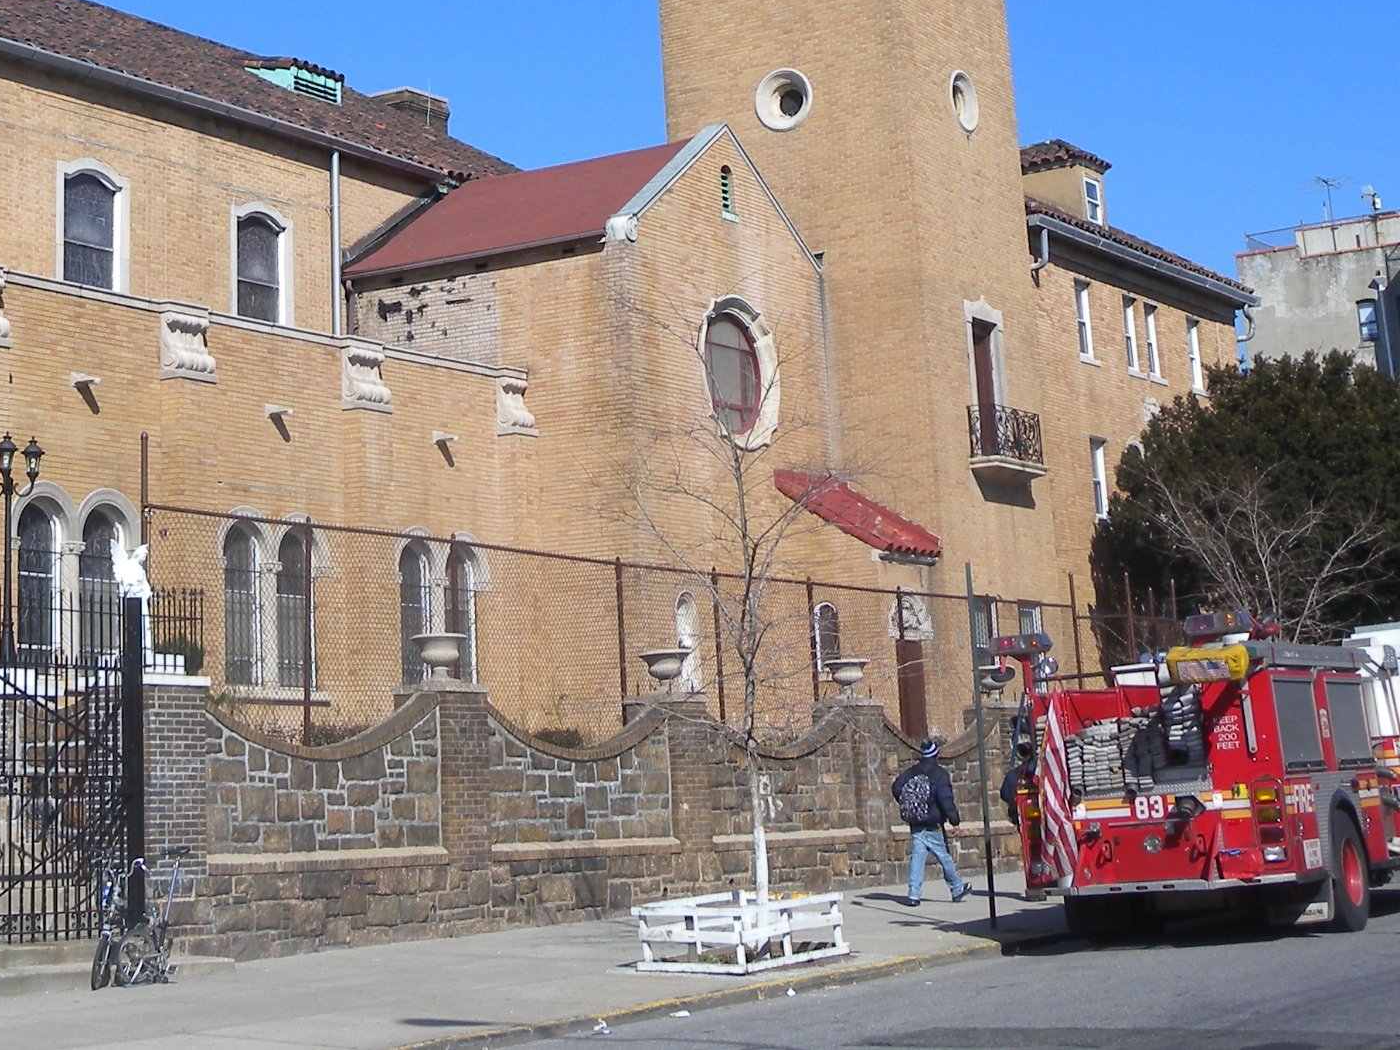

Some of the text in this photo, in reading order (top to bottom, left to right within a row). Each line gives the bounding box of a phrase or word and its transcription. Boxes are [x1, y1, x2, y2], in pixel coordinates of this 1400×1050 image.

[1213, 715, 1238, 724] KEEP
[1213, 724, 1240, 733] BACK
[1218, 733, 1238, 741] 200
[1216, 741, 1240, 750] FEET
[1293, 783, 1313, 813] FIRE
[1135, 795, 1165, 820] 83
